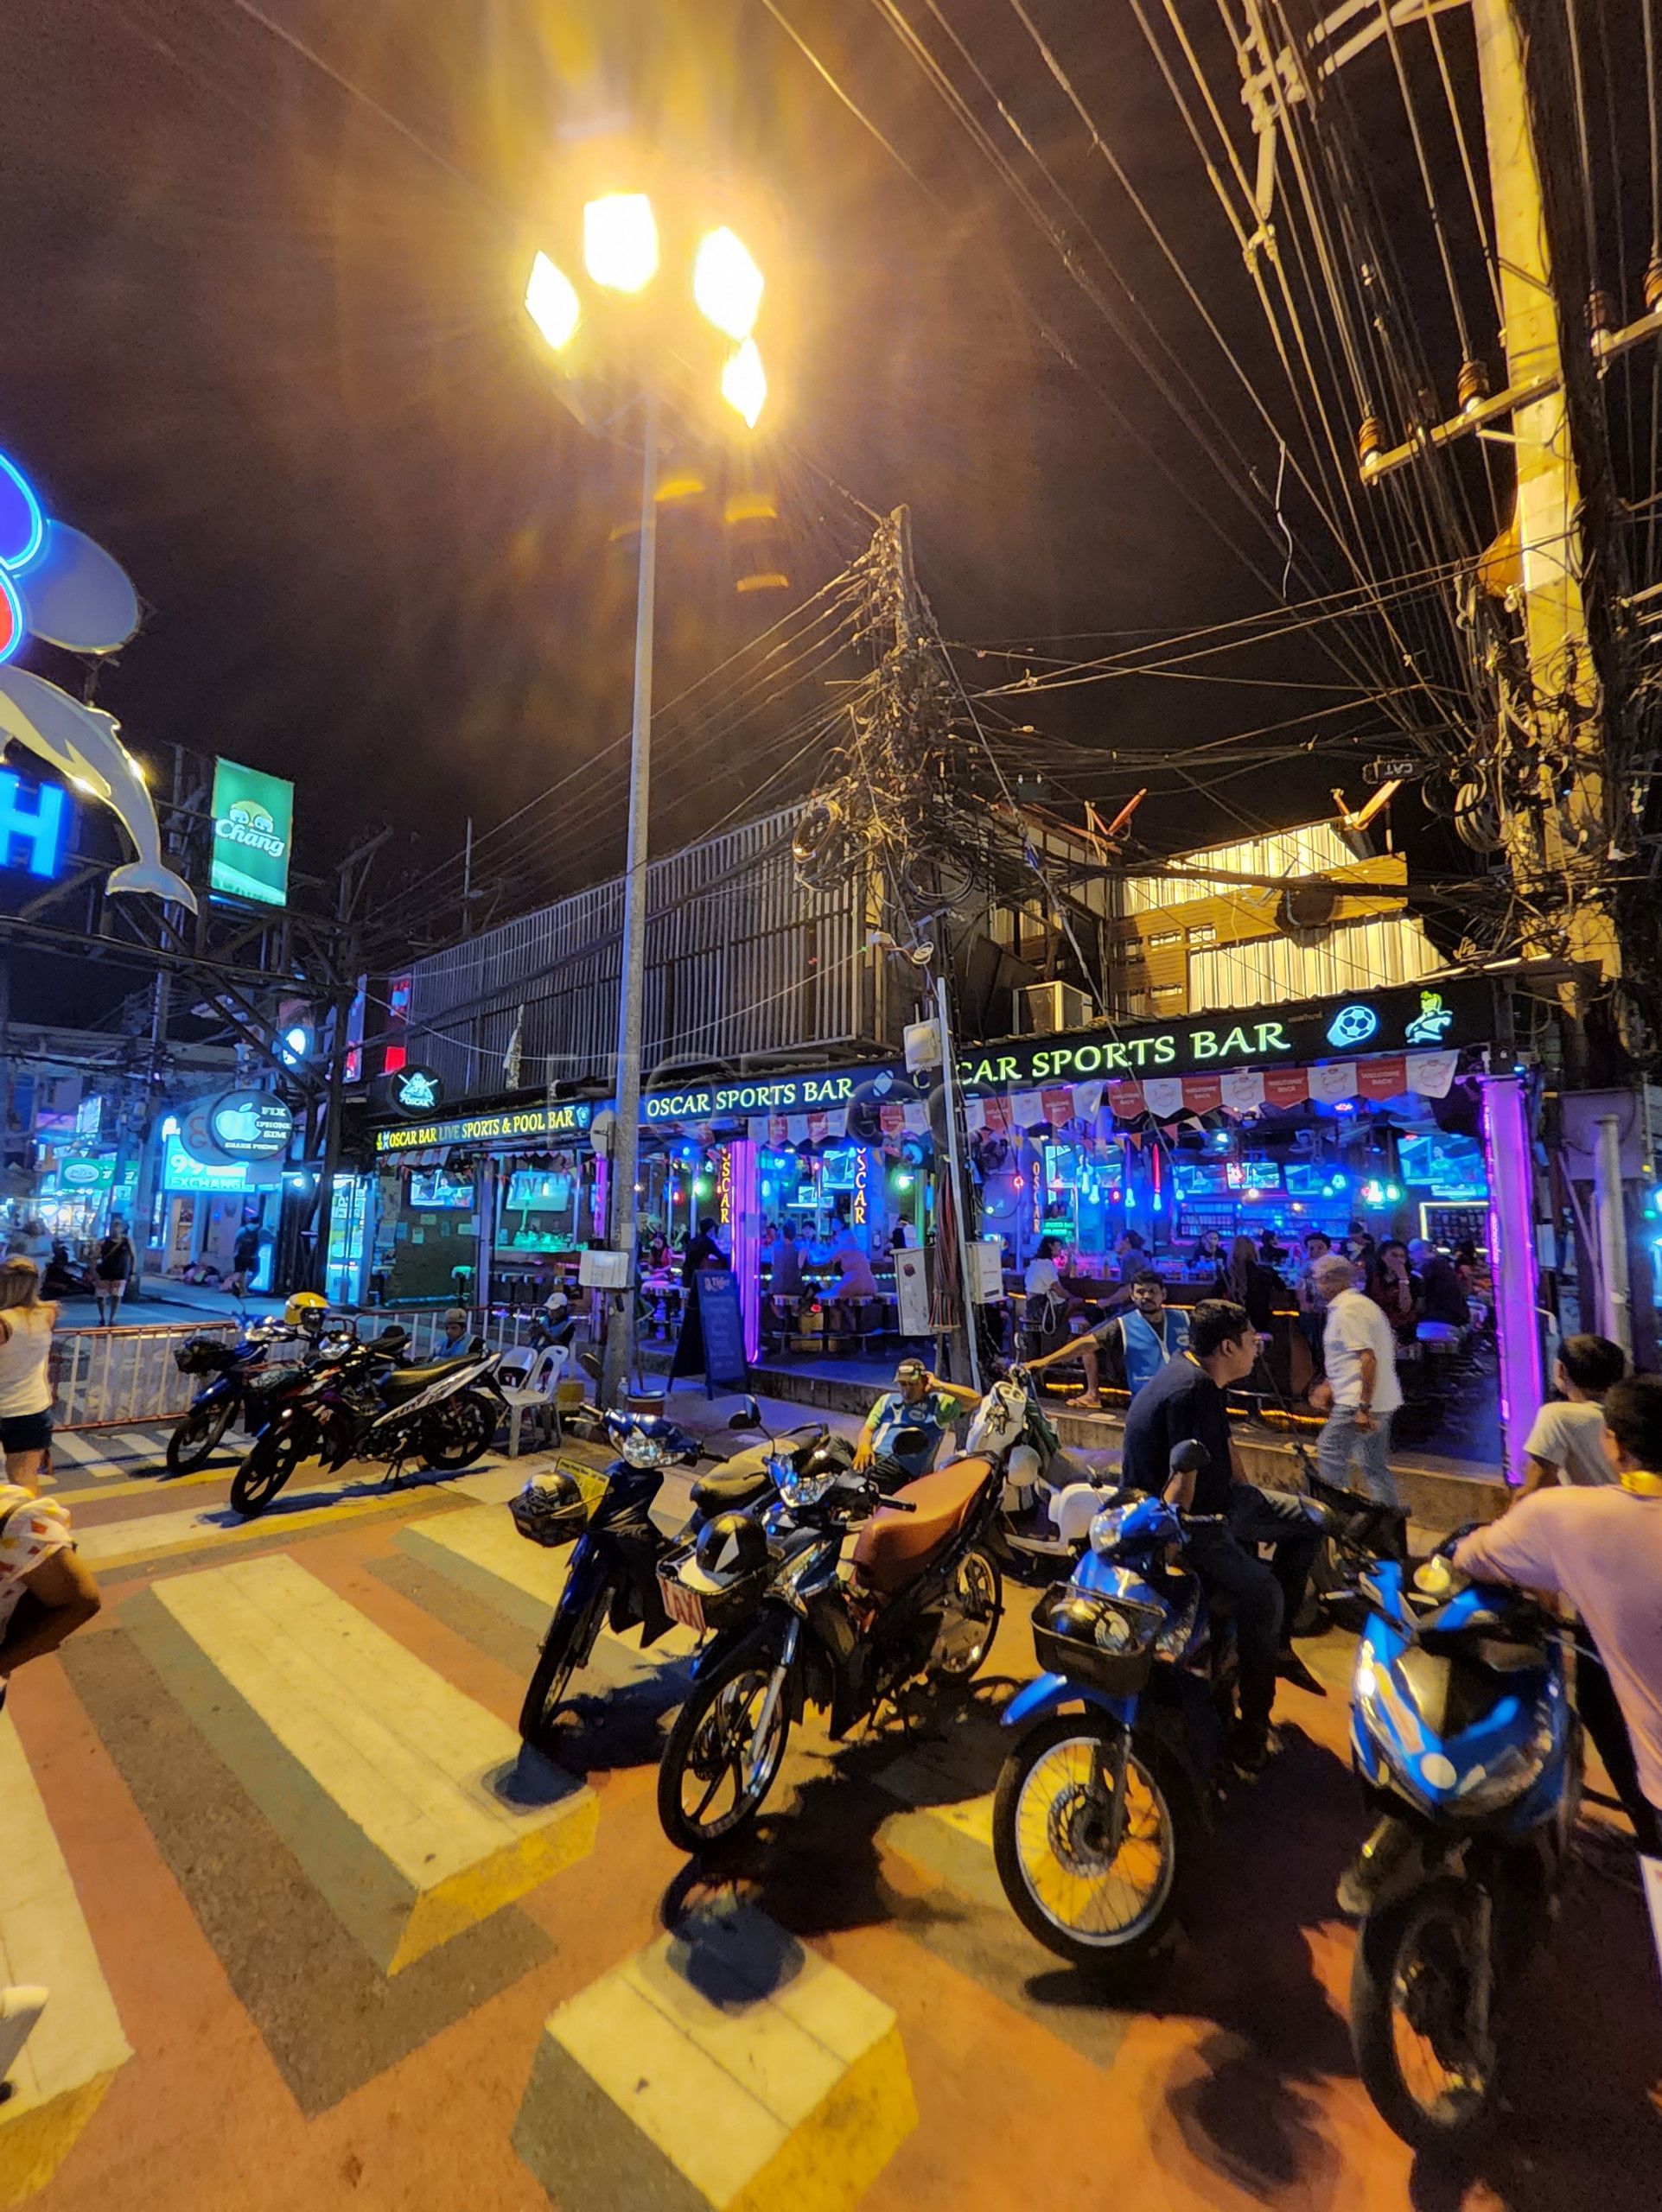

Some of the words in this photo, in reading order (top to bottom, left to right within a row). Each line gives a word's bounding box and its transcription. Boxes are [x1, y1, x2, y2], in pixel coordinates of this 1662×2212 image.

[1385, 763, 1413, 775] CAT
[216, 818, 285, 857] Chang
[1032, 1036, 1175, 1077] SPORTS
[1189, 1022, 1291, 1059] BAR
[262, 1107, 286, 1116] FIX
[647, 1093, 711, 1117] OSCAR
[716, 1084, 796, 1110] SPORTS
[803, 1078, 856, 1102] BAR
[263, 1130, 287, 1139] SIM
[389, 1130, 417, 1147] OSCAR
[418, 1128, 437, 1144] BAR
[439, 1124, 460, 1141] LIVE
[462, 1118, 500, 1138] SPORTS
[502, 1117, 512, 1134] &
[513, 1113, 545, 1133] POOL
[547, 1109, 575, 1129] BAR
